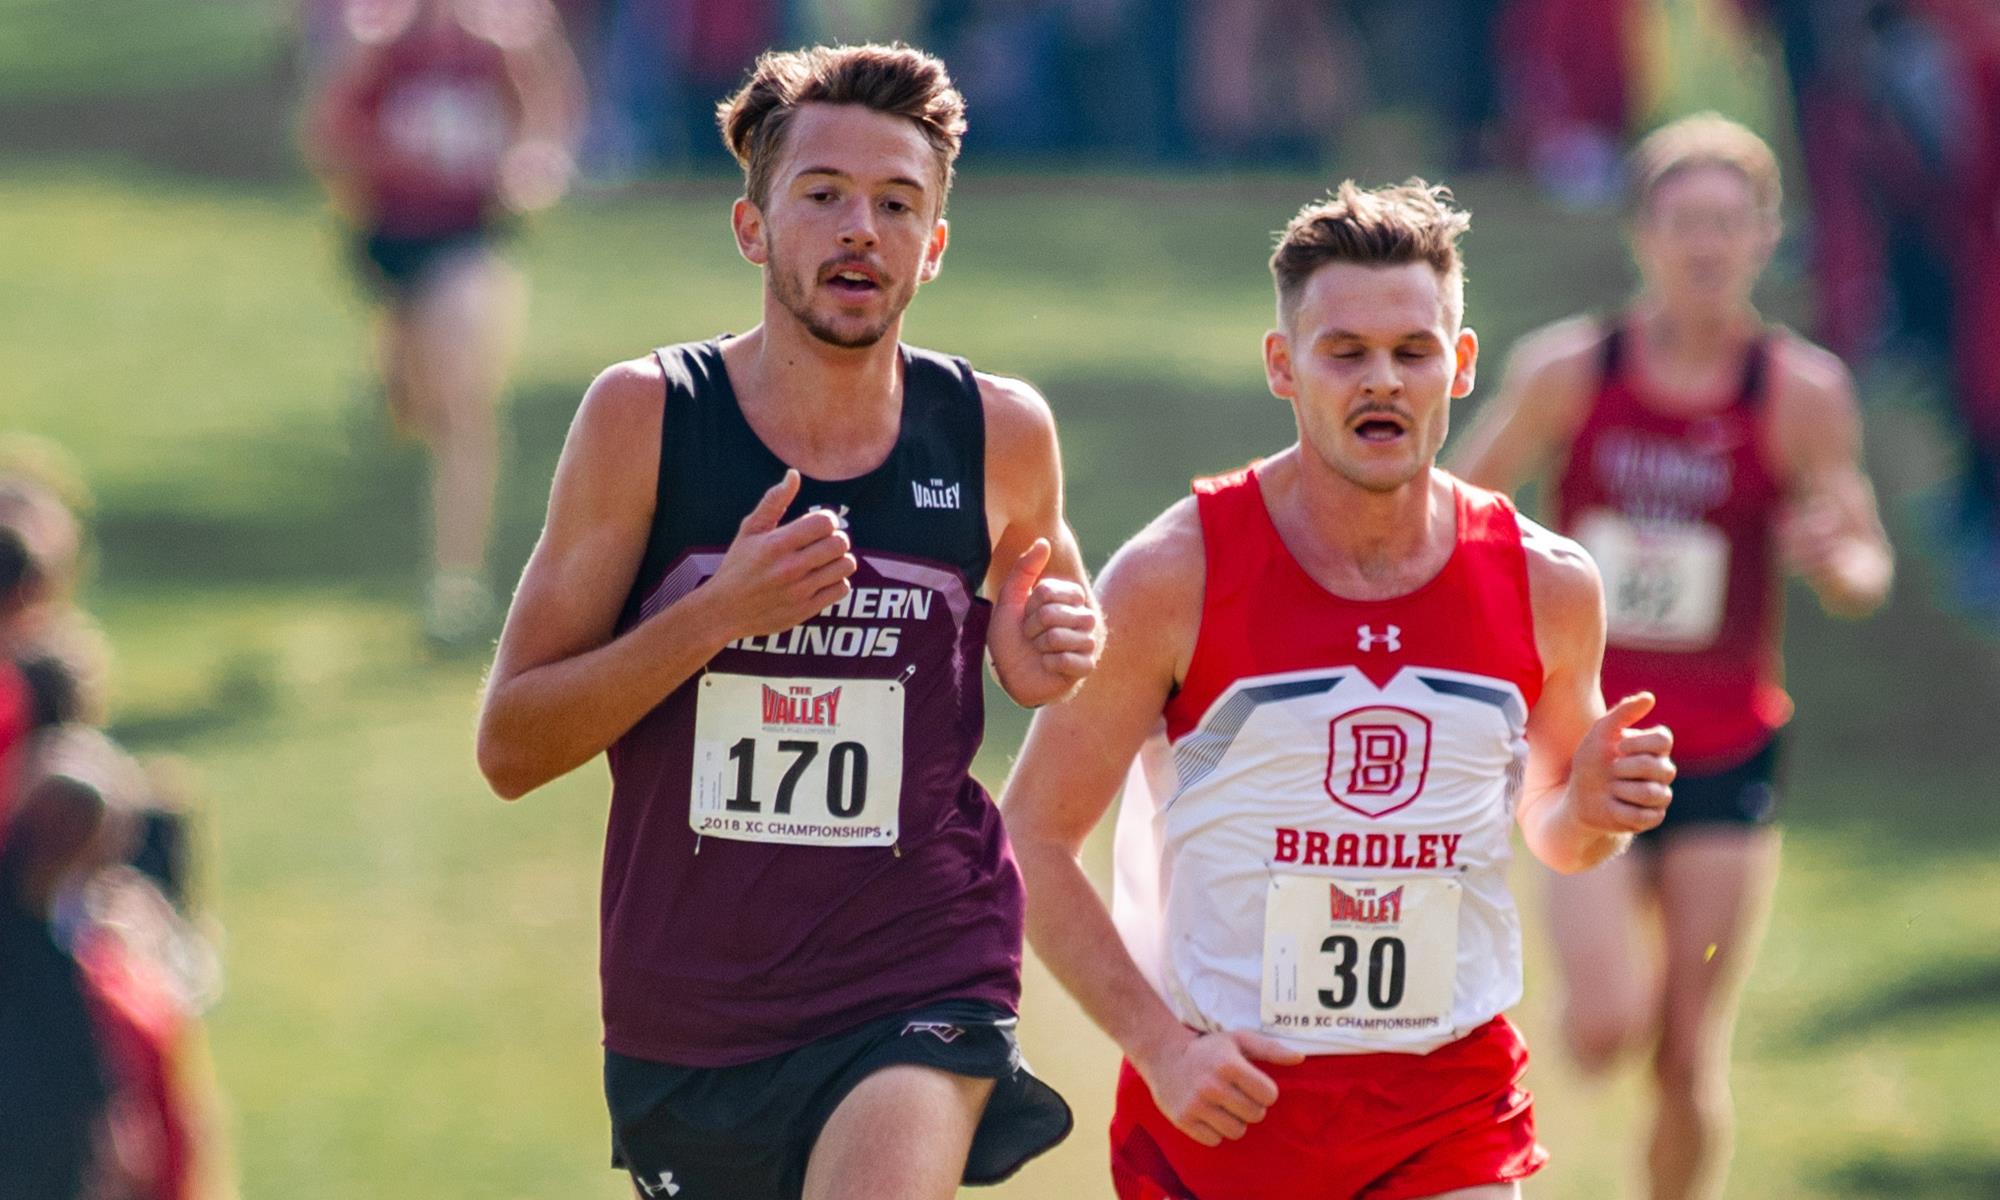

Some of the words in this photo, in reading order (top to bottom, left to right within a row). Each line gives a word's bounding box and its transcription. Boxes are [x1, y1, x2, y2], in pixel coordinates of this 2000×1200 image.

[912, 481, 959, 509] VALLEY
[820, 588, 933, 620] HERN
[762, 683, 841, 726] VALLEY
[726, 737, 868, 819] 170
[704, 817, 740, 831] 2018
[745, 821, 763, 833] XC
[768, 822, 881, 838] CHAMPIONSHIPS
[1274, 828, 1462, 869] BRADLEY
[1330, 883, 1404, 923] VALLEY
[1318, 935, 1406, 1011] 30
[1274, 1015, 1309, 1026] 2018
[1314, 1016, 1332, 1027] XC
[1336, 1016, 1439, 1030] CHAMPIONSHIPS
